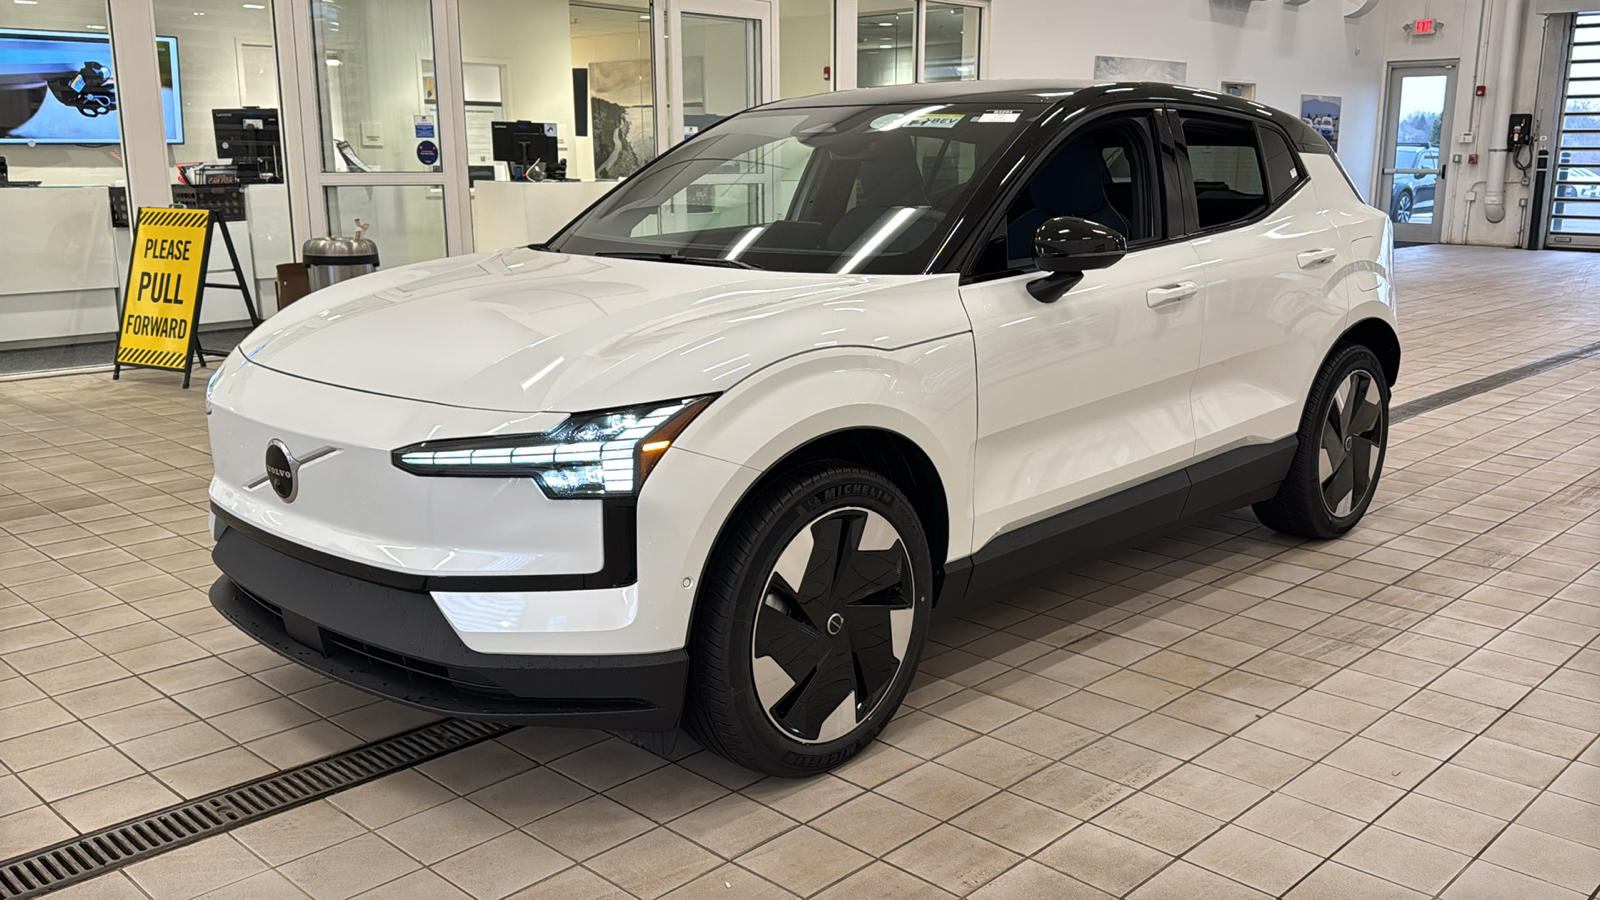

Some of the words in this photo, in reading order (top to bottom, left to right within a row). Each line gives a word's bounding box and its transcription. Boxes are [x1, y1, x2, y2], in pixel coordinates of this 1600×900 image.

[1415, 19, 1433, 33] EXIT
[144, 239, 191, 260] PLEASE
[137, 271, 184, 304] PULL
[125, 315, 187, 339] FORWARD
[267, 465, 291, 478] VOLVO
[824, 484, 892, 503] MICHELIN
